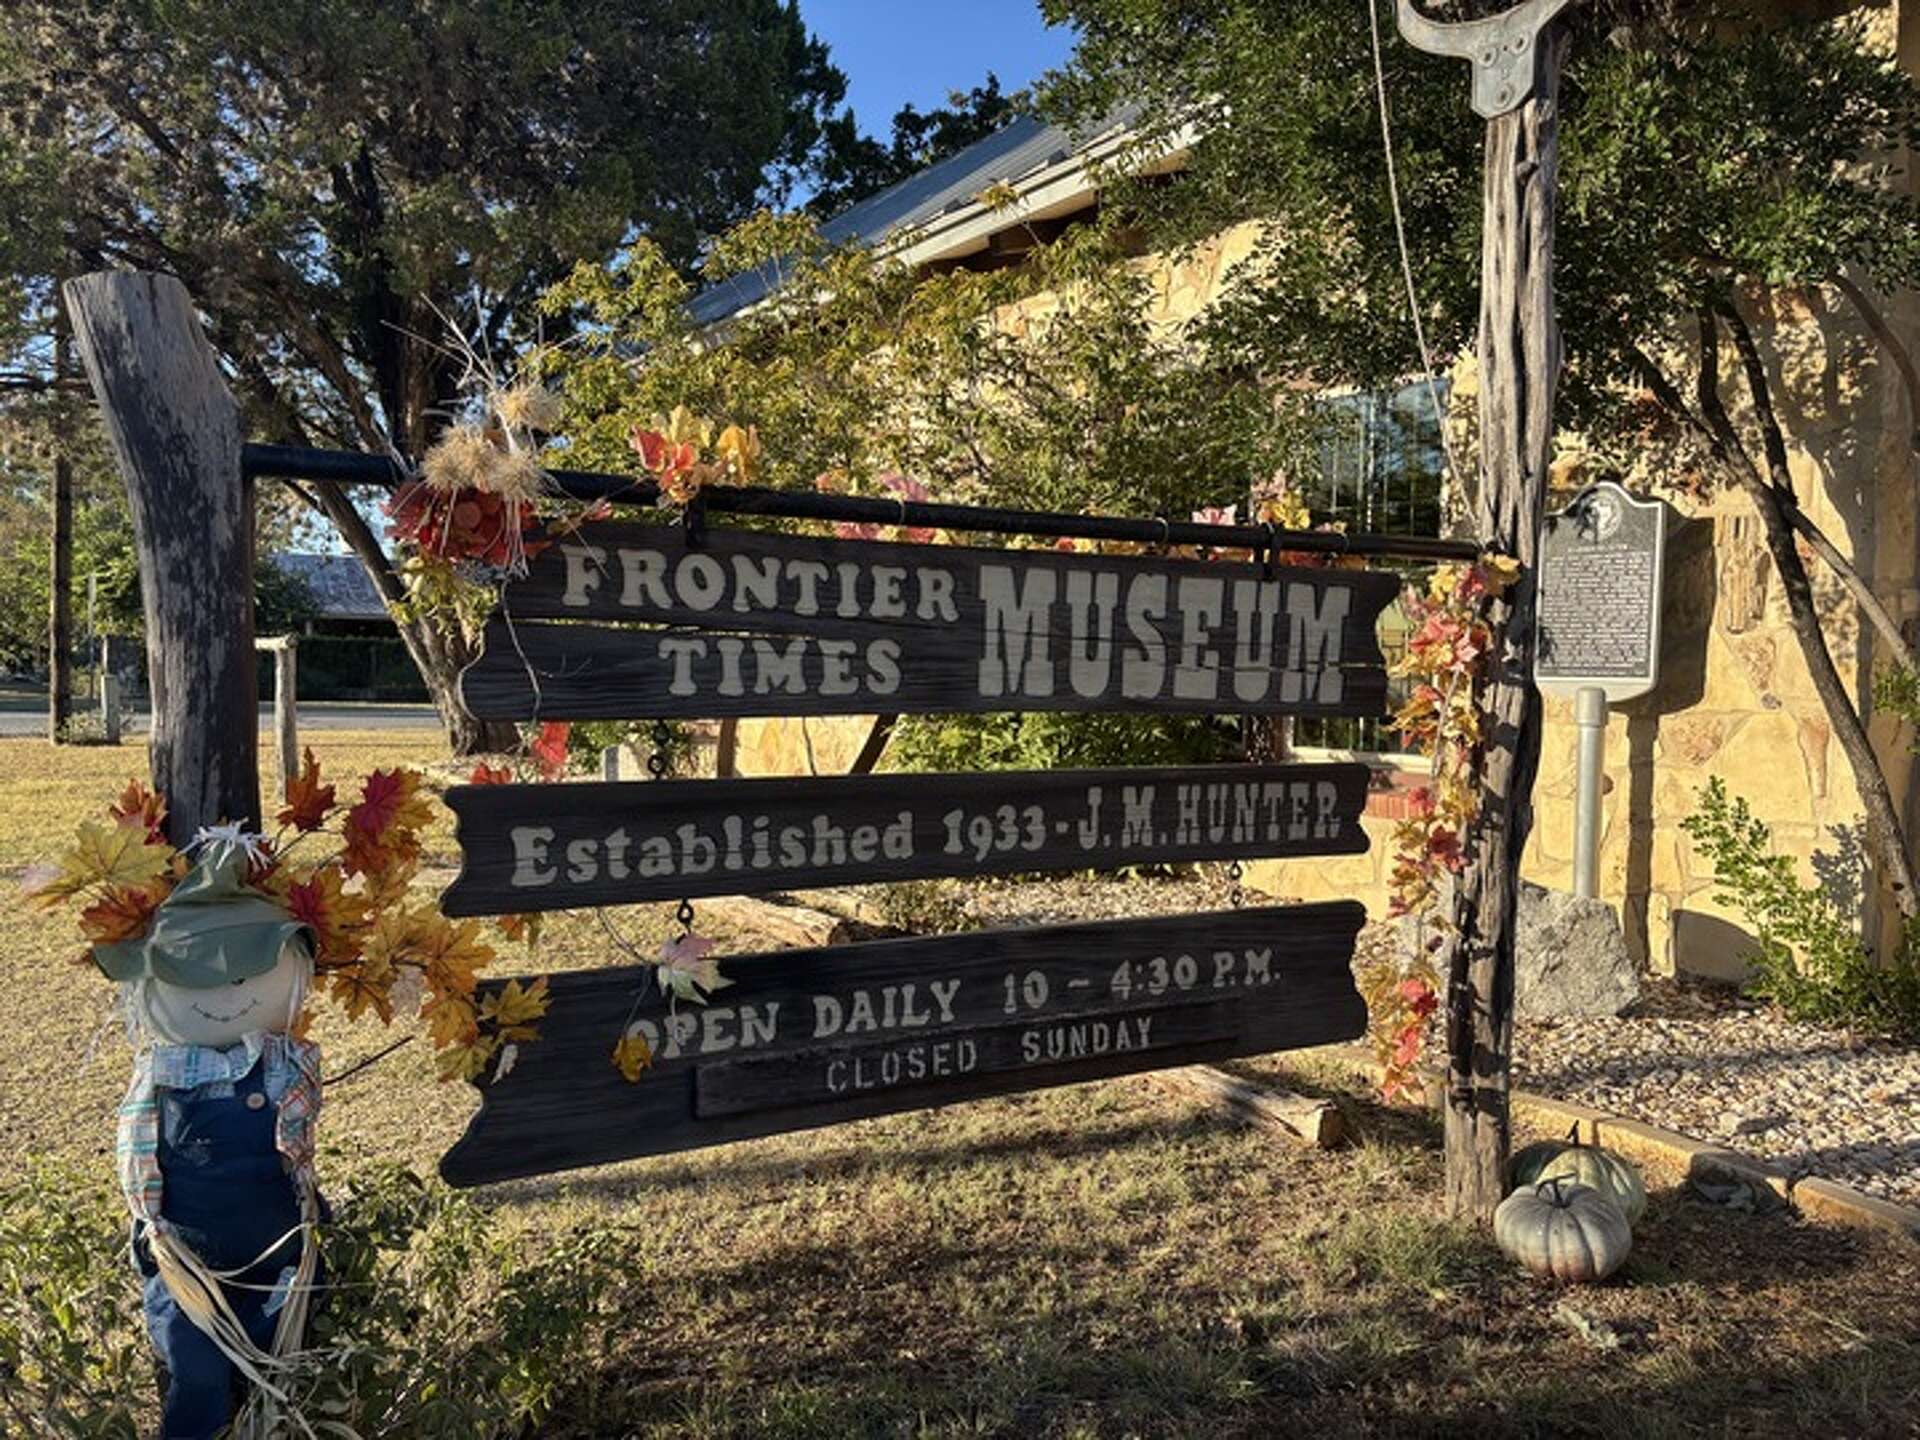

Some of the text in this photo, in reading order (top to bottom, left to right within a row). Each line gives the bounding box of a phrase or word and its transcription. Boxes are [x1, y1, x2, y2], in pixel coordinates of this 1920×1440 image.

[560, 544, 959, 622] FRONTIER
[658, 638, 902, 695] TIMES
[978, 565, 1351, 704] MUSEUM
[511, 811, 914, 887] Established
[812, 979, 961, 1038] DAILY
[1003, 970, 1050, 1014] 10
[1111, 959, 1199, 1000] 4:30
[827, 1017, 1152, 1093] CLOSED SUNDAY
